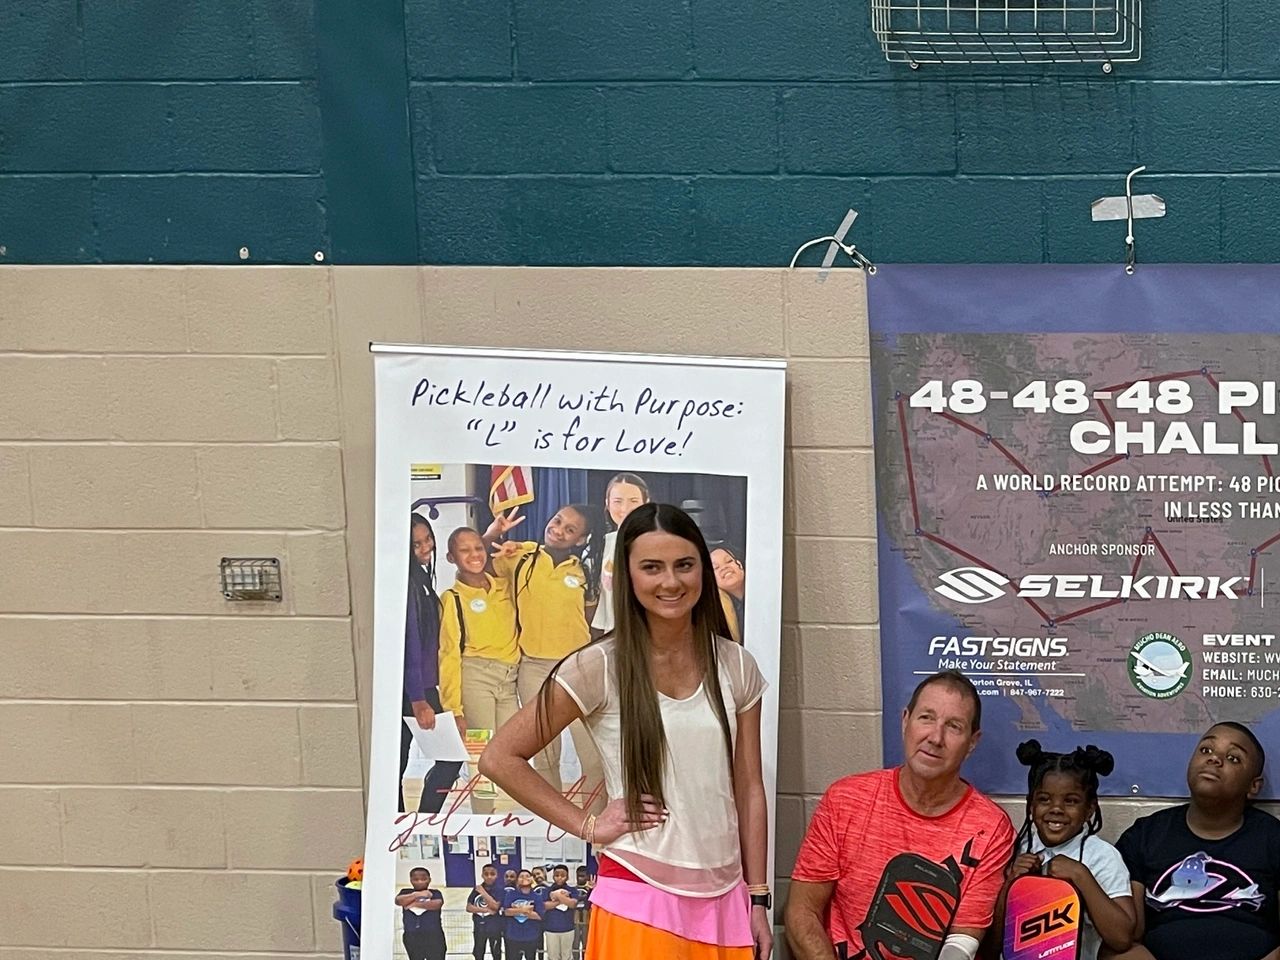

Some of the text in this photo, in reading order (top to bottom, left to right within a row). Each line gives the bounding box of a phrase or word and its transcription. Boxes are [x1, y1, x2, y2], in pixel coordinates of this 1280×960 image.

[412, 378, 744, 431] Pickleball with Purpose:
[909, 380, 1194, 414] 48-48-48
[534, 429, 553, 450] is
[563, 415, 605, 452] for
[615, 429, 693, 457] Love!
[976, 474, 988, 491] A
[993, 474, 1055, 492] WORLD
[1060, 474, 1131, 492] RECORD
[1136, 475, 1223, 493] ATTEMPT:
[1229, 475, 1251, 493] 48
[1164, 501, 1182, 518] IN
[1188, 501, 1232, 519] LESS
[1049, 543, 1155, 557] ANCHOR SPONSOR
[1016, 574, 1245, 600] SELKIRK
[1202, 634, 1276, 647] EVENT
[938, 658, 1056, 671] Make Your Statement
[1202, 651, 1261, 664] WEBSITE:
[1202, 668, 1244, 681] EMAIL:
[997, 678, 1022, 688] Grove,
[1024, 679, 1033, 687] IL
[1010, 688, 1064, 697] 847-967-7222
[1202, 686, 1247, 698] PHONE:
[1019, 902, 1075, 943] SLK
[1038, 939, 1076, 959] LATITUDE
